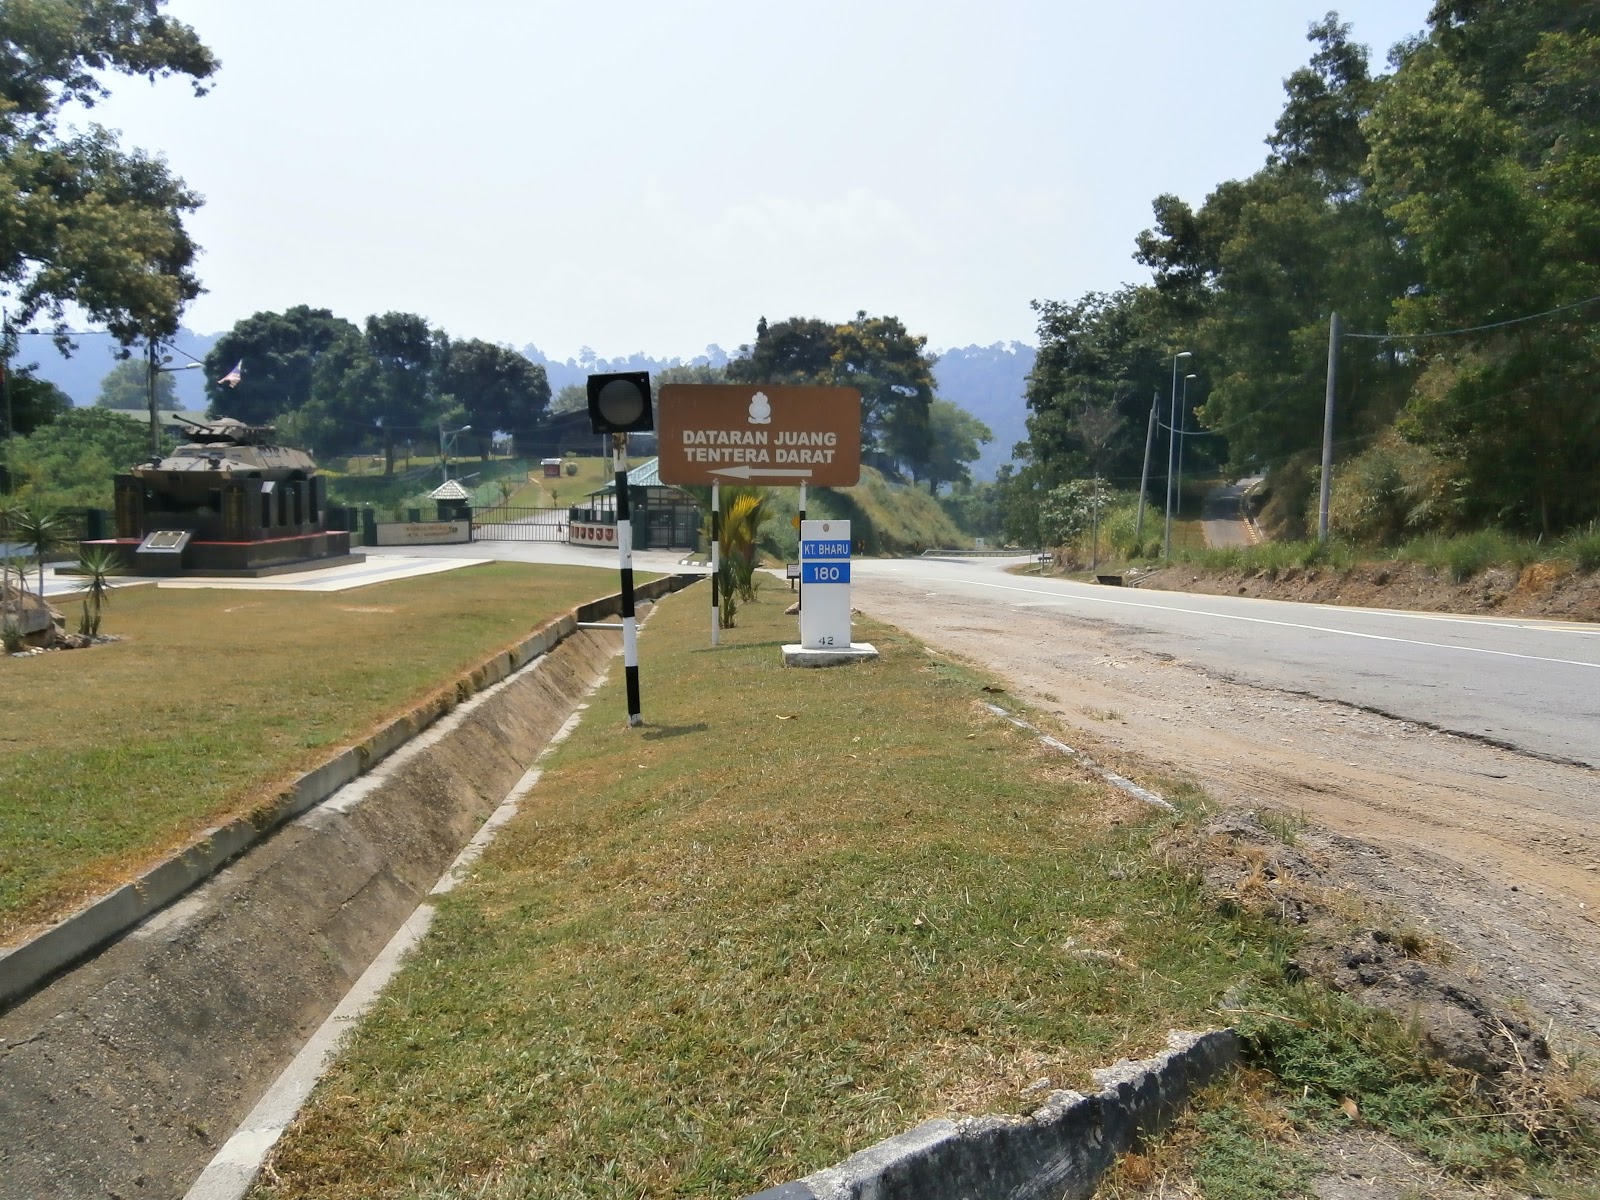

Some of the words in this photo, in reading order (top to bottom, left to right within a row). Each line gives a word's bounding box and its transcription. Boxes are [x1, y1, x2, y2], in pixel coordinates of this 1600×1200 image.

[683, 430, 768, 445] DATARAN
[773, 431, 837, 446] JUANG
[684, 447, 769, 463] TENTERA
[775, 449, 836, 464] DARAT
[804, 544, 816, 555] KT.
[819, 544, 849, 555] BHARU
[814, 567, 839, 580] 180
[818, 636, 834, 645] 42
